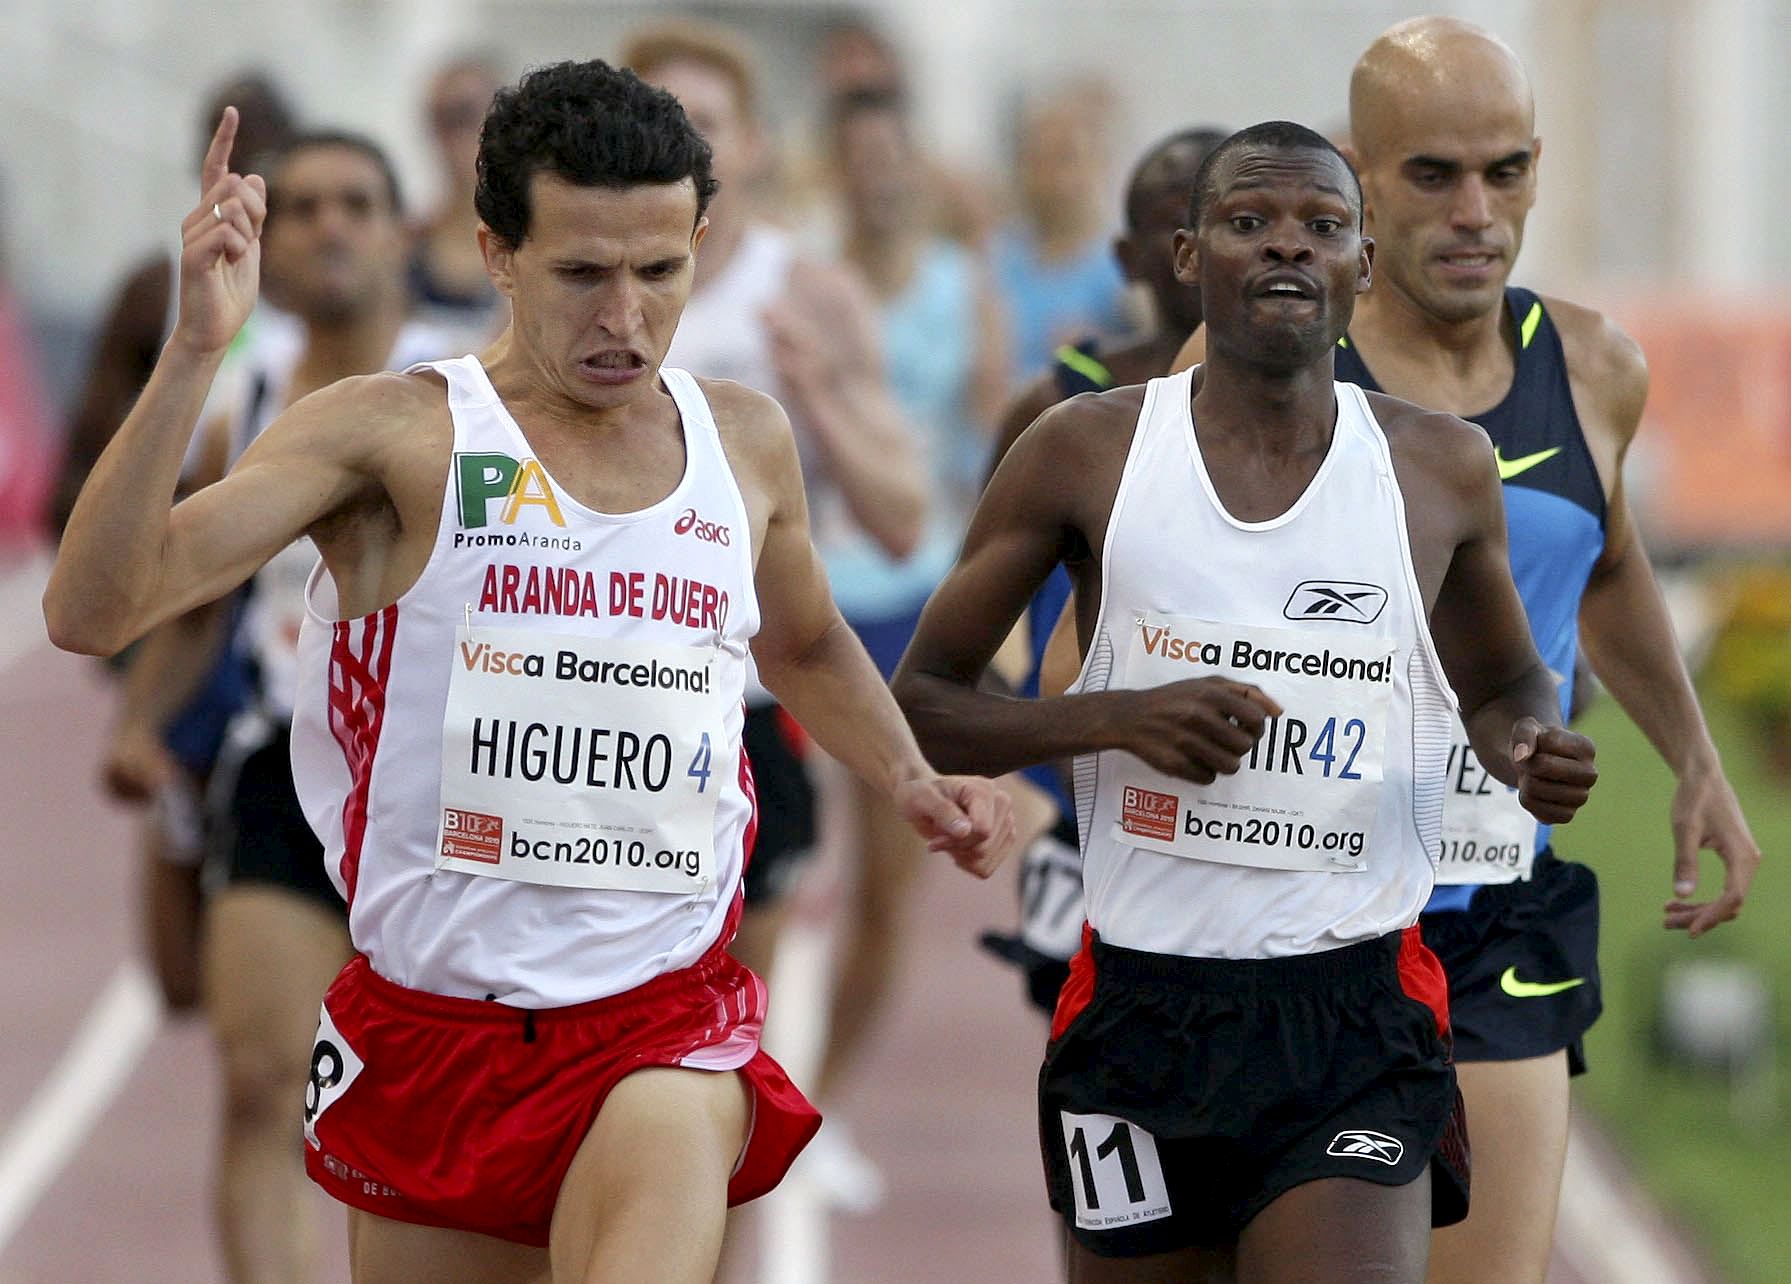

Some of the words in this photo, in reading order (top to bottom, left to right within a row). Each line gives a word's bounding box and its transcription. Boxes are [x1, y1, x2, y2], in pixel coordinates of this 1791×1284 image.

[454, 451, 567, 529] PA
[454, 532, 582, 551] PromoAranda
[478, 563, 599, 618] ARANDA
[608, 571, 646, 618] DE
[651, 572, 730, 634] DUERO
[460, 641, 544, 678] Visca
[555, 650, 711, 694] Barcelona!
[1141, 625, 1221, 667] Visca
[1231, 640, 1392, 684] Barcelona!
[470, 717, 673, 793] HIGUERO
[686, 731, 712, 794] 4
[1308, 716, 1367, 780] 42
[510, 831, 700, 877] bcn2010.org
[1184, 810, 1365, 857] bcn2010.org
[1070, 1121, 1147, 1210] 11
